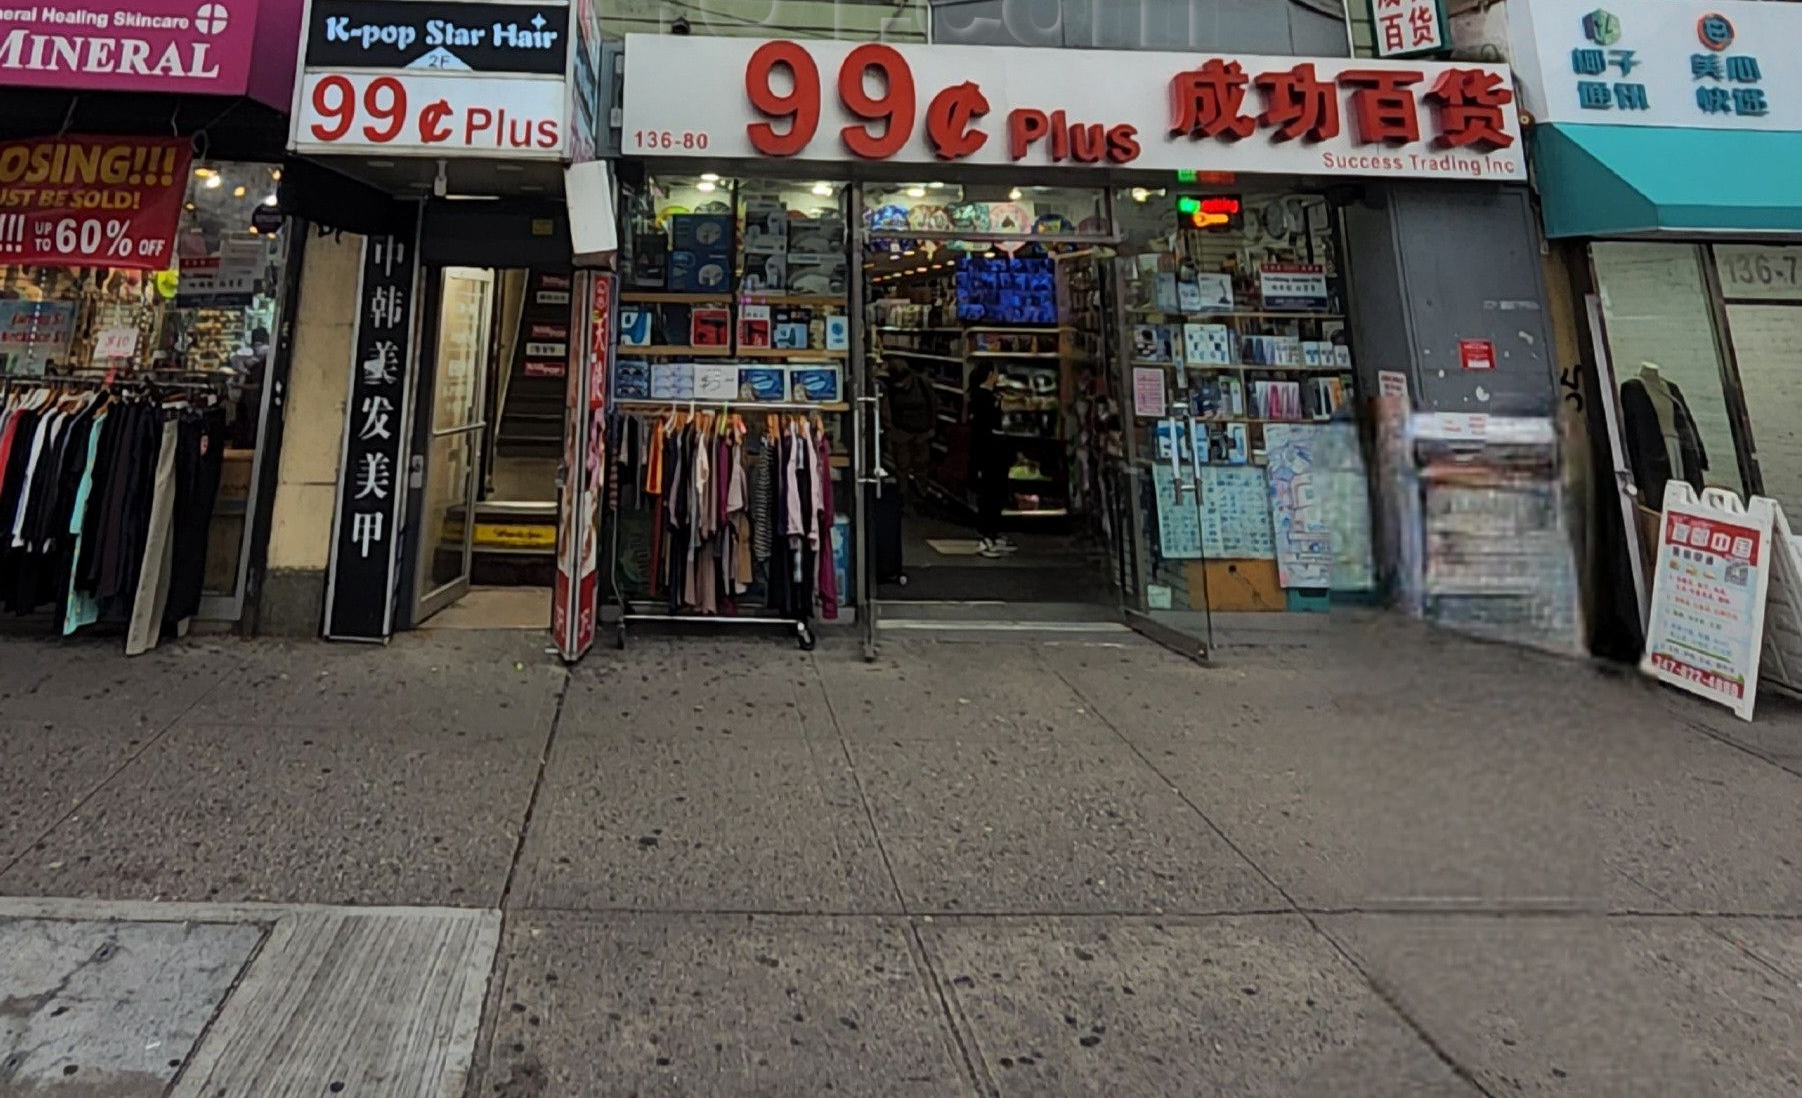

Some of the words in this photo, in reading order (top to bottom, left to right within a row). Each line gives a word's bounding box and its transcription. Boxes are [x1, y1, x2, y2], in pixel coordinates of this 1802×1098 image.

[42, 7, 109, 28] Healing
[113, 11, 189, 31] Skincare
[1380, 6, 1435, 52] 百货
[325, 16, 416, 51] K-pop
[425, 19, 485, 47] Star
[492, 12, 558, 50] Hair
[428, 55, 452, 69] 2F
[1168, 57, 1514, 150] 成功百货
[464, 108, 559, 149] Plus
[634, 130, 709, 150] 136-80
[1006, 107, 1141, 164] Plus
[0, 143, 176, 187] OSING!!!
[1322, 152, 1403, 171] Success
[1409, 154, 1481, 176] Trading
[1486, 156, 1515, 174] Inc
[39, 188, 69, 208] BE
[70, 189, 141, 210] SOLD!
[35, 221, 52, 235] UP
[55, 217, 133, 257] 60%
[35, 238, 51, 252] TO
[138, 239, 166, 257] OFF
